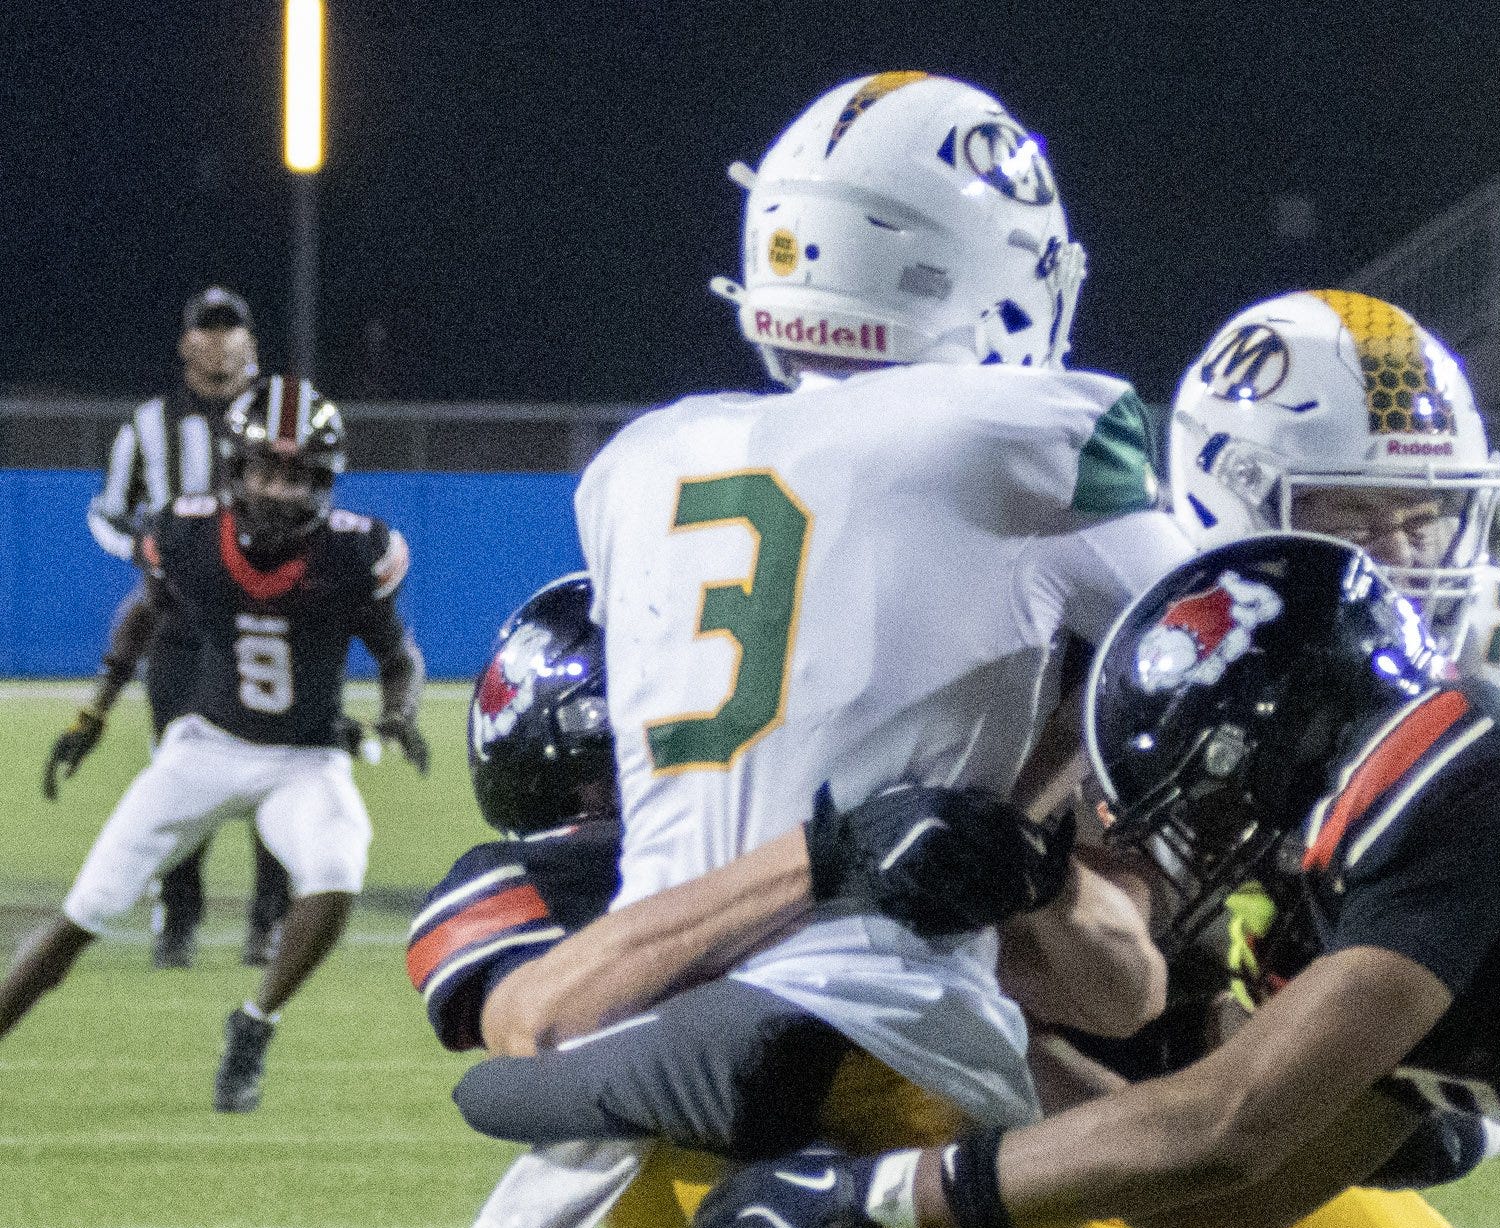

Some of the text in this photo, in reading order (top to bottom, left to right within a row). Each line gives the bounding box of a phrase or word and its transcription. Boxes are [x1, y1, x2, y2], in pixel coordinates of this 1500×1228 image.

[755, 309, 887, 353] Riddell
[643, 467, 814, 776] 3
[235, 634, 294, 713] 9
